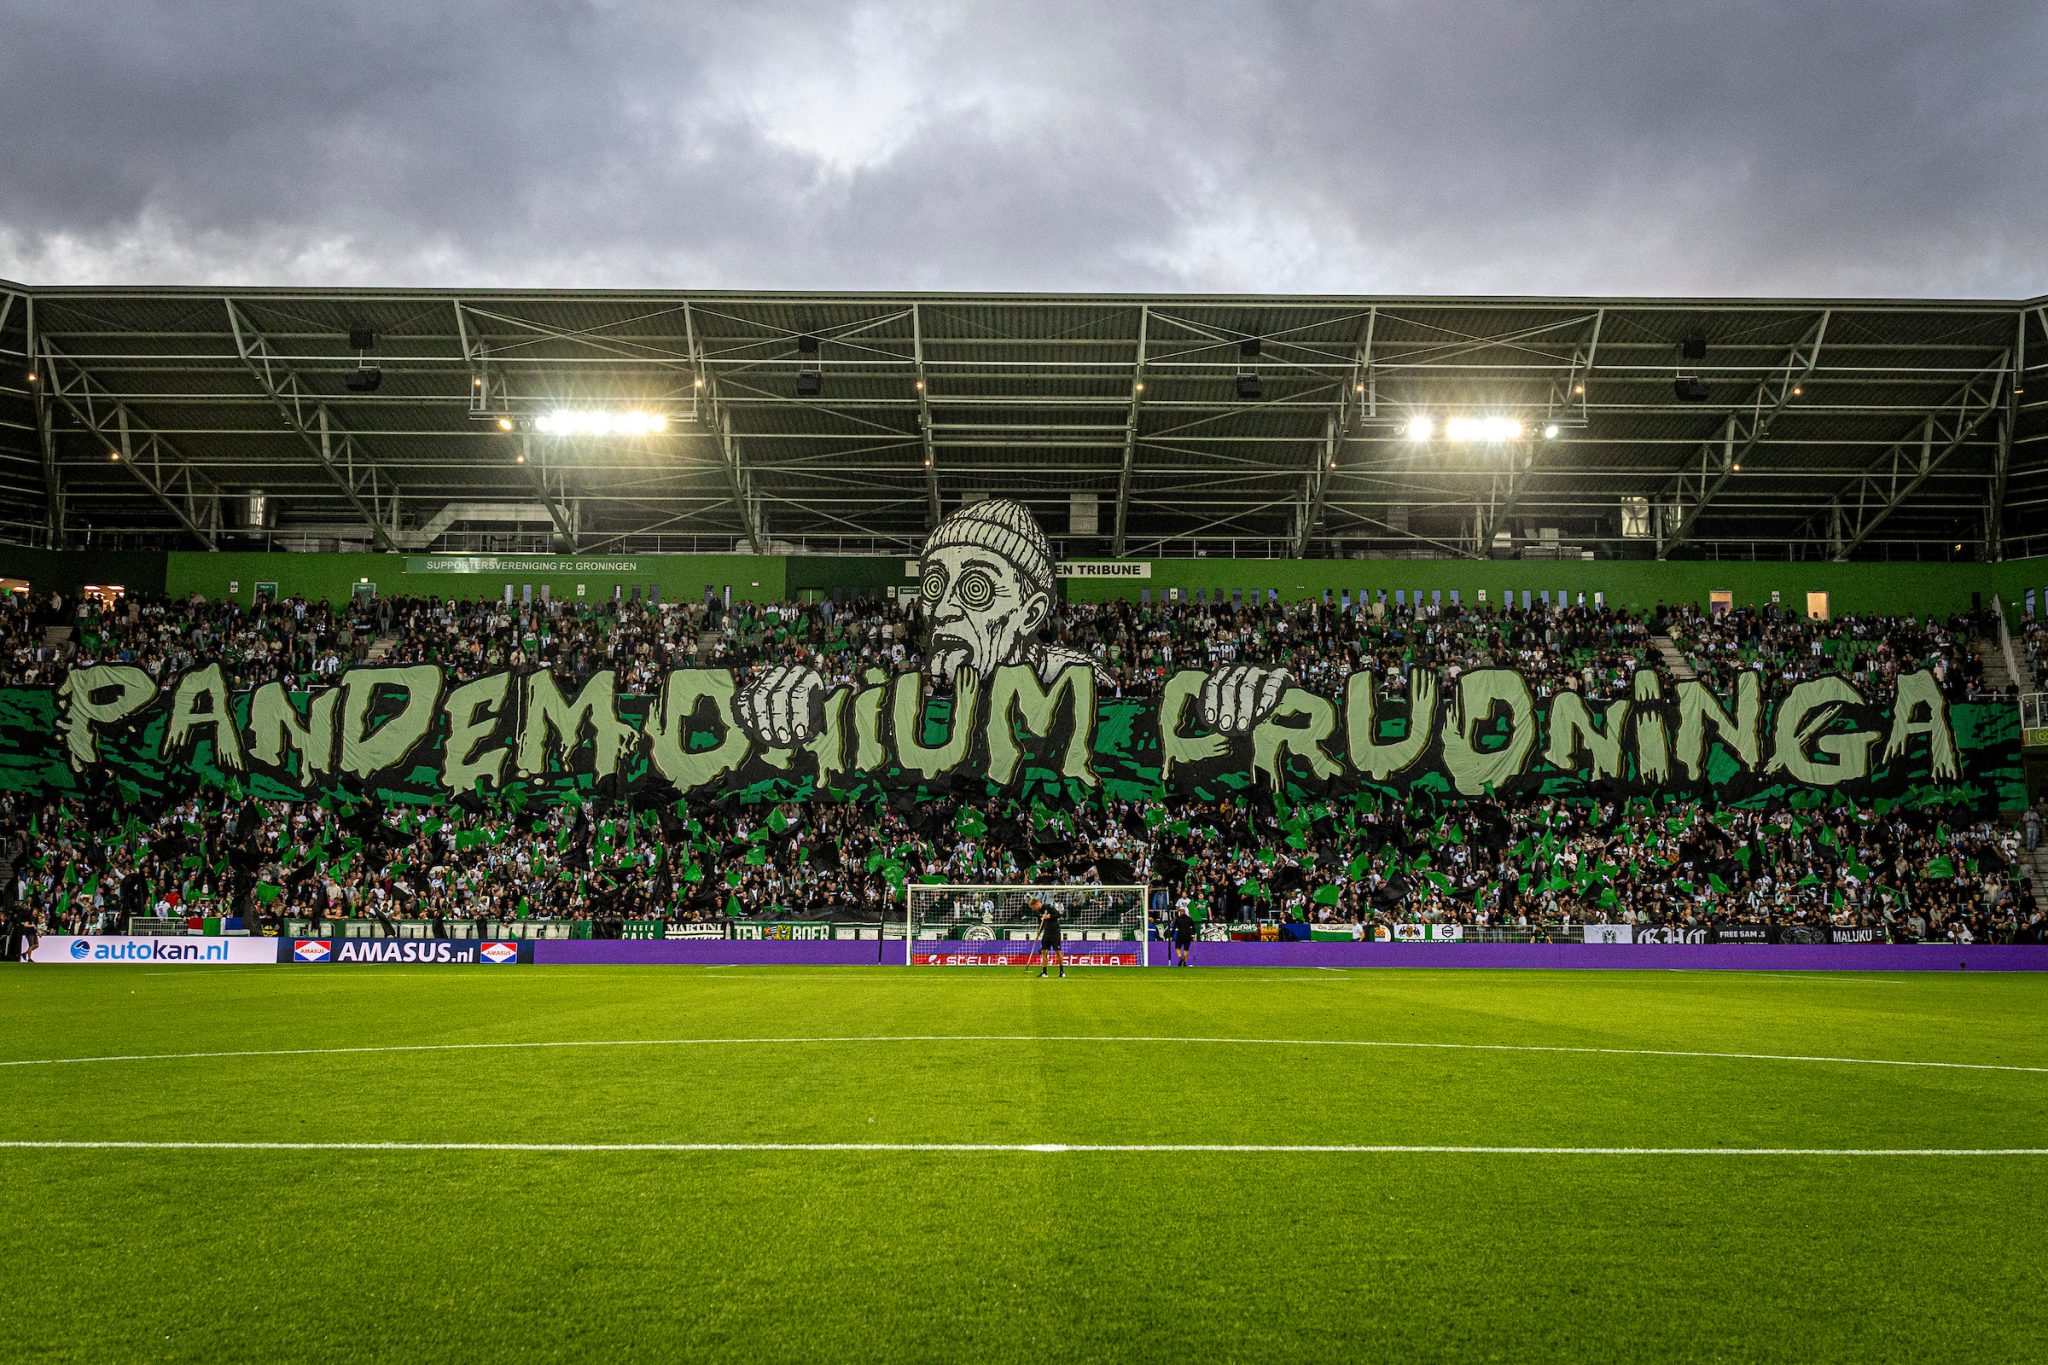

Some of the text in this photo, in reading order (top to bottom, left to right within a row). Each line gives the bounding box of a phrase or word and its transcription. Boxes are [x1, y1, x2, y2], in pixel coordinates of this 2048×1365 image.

[427, 560, 637, 572] SUPPORTERSVERENIGING FC GRONINGEN
[1077, 564, 1141, 576] TRIBUNE
[666, 923, 722, 932] MARTINI
[1719, 930, 1739, 938] FREE
[1739, 930, 1757, 938] SAM
[1832, 929, 1873, 943] MALUKU
[94, 939, 229, 961] autokan.nl
[337, 941, 474, 963] AMASUS.nl
